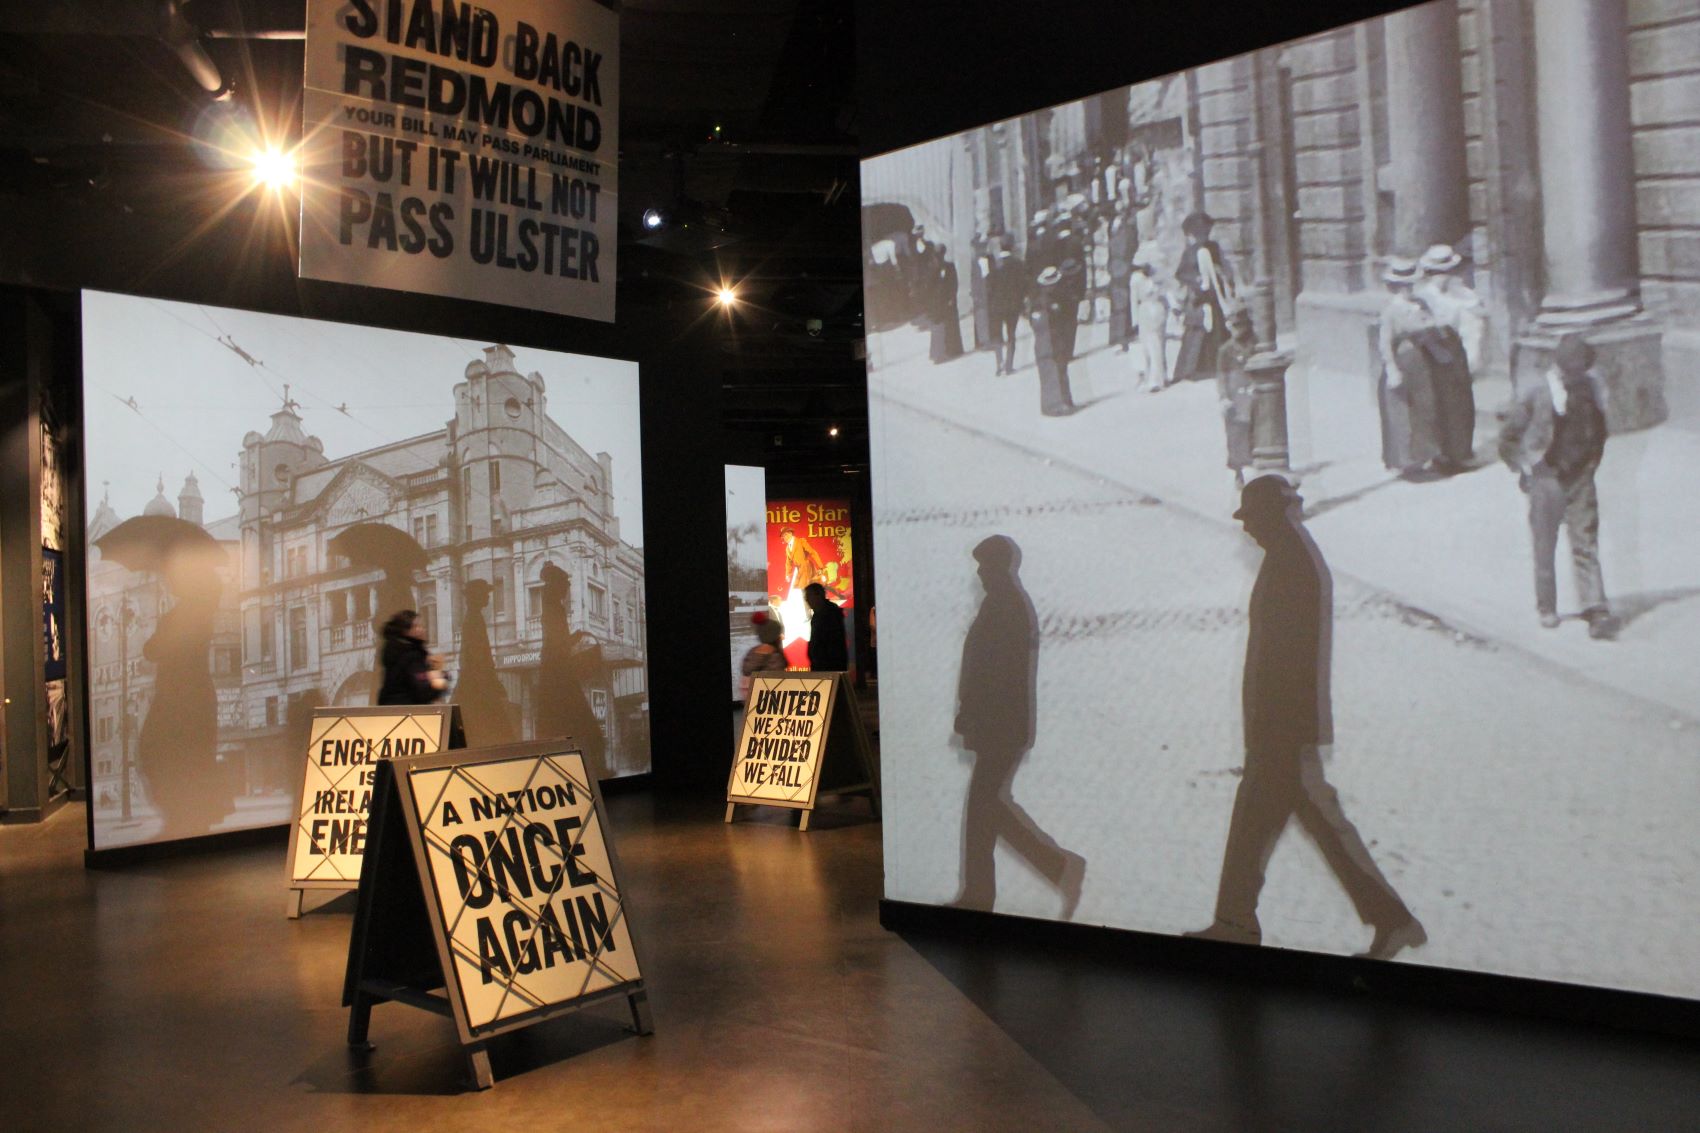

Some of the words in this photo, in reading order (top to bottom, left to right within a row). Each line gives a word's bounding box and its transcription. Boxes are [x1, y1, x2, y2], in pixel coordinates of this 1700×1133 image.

[345, 0, 499, 68] STAND
[514, 20, 602, 107] BACK
[344, 44, 601, 153] REDMOND
[344, 105, 396, 128] YOUR
[401, 116, 438, 136] BILL
[443, 125, 478, 145] MAY
[482, 134, 519, 154] PASS
[523, 144, 600, 175] PARLIAMENT
[342, 130, 418, 186] BUT
[428, 146, 460, 194] IT
[469, 154, 542, 211] WILL
[552, 173, 600, 223] NOT
[339, 186, 455, 258] PASS
[470, 208, 599, 282] ULSTER
[766, 506, 800, 523] hite
[806, 504, 848, 522] Star
[808, 523, 846, 537] Line
[755, 690, 821, 716] UNITED
[754, 717, 773, 735] WE
[775, 718, 813, 737] STAND
[320, 738, 426, 766] ENGLAND
[746, 737, 811, 762] DIVIDED
[359, 771, 377, 786] IS
[744, 762, 767, 784] WE
[769, 765, 802, 787] FALL
[314, 790, 372, 814] IRELA
[442, 801, 463, 827] A
[470, 782, 577, 822] NATION
[309, 819, 368, 855] ENE
[450, 816, 598, 909] ONCE
[477, 892, 616, 985] AGAIN
